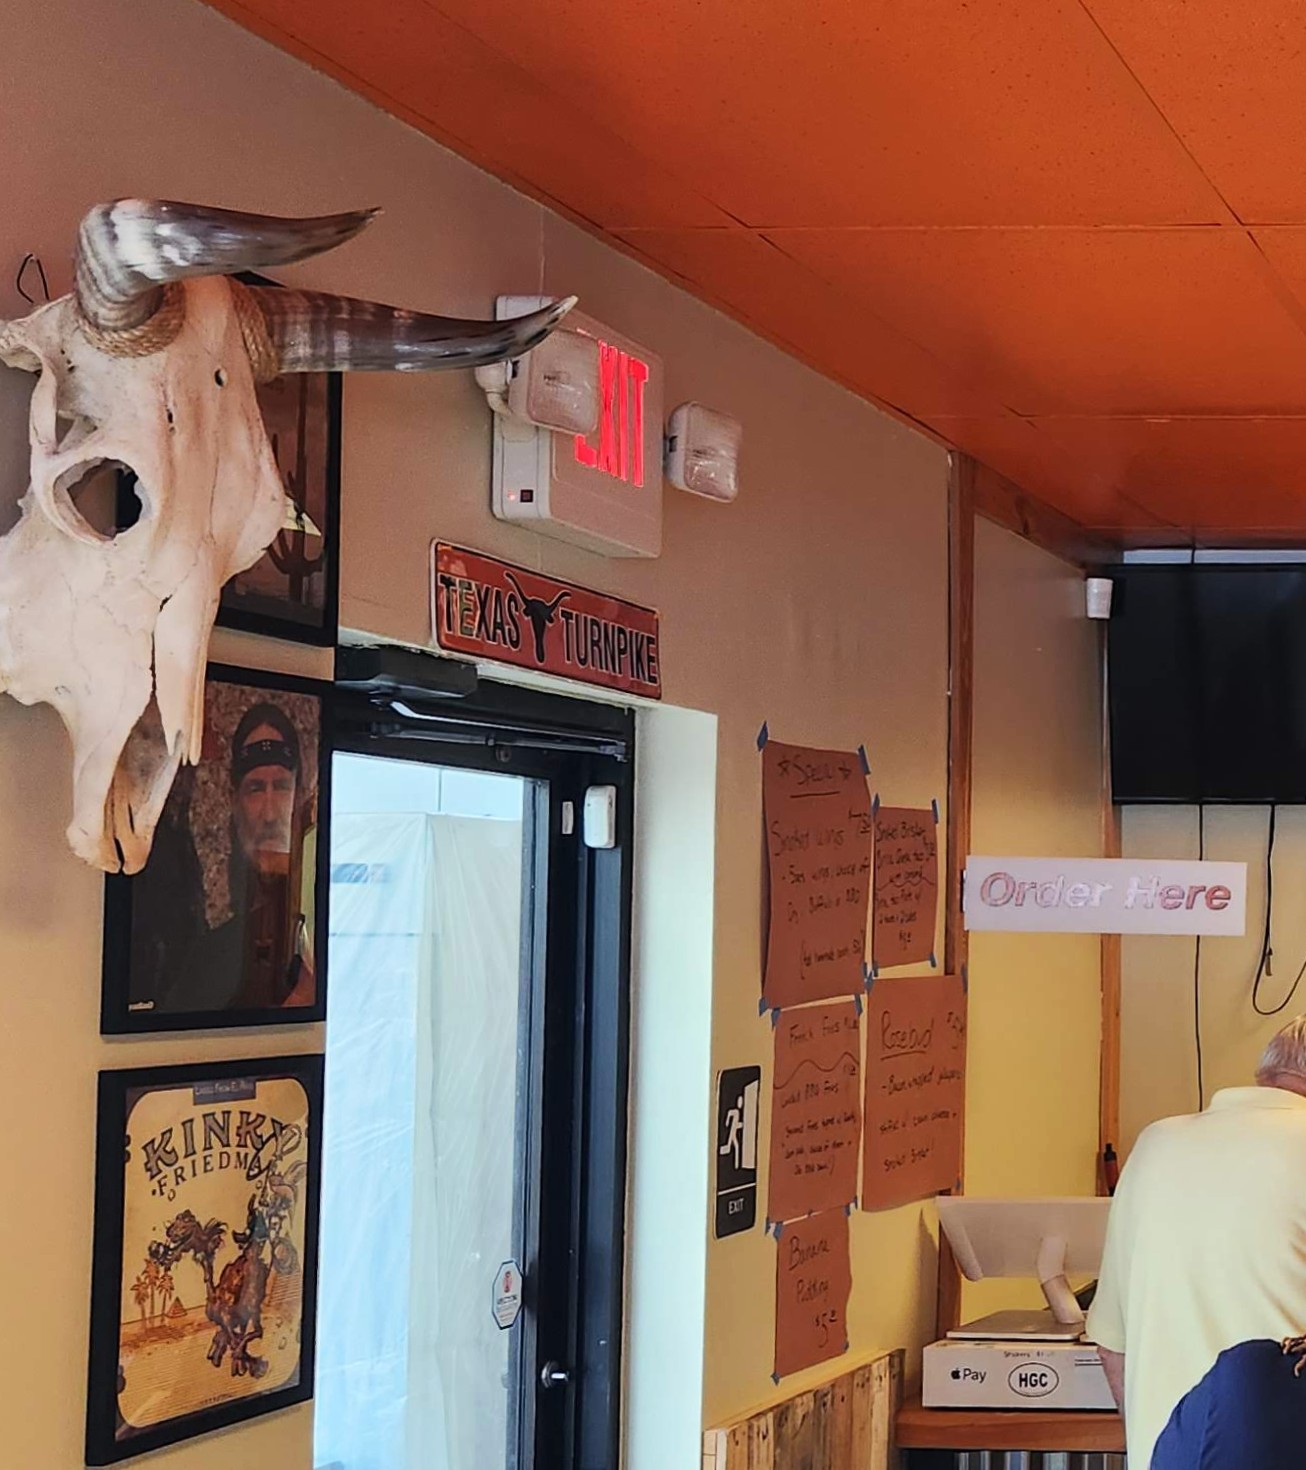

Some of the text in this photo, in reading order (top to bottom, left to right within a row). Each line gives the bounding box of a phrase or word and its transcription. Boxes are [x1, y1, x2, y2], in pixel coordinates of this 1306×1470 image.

[573, 339, 649, 488] XIT
[437, 572, 659, 686] TEXAS TURNPIKE
[980, 871, 1231, 911] Order Here
[141, 1110, 292, 1182] KINKY
[728, 1198, 744, 1215] EXIT
[963, 1368, 986, 1384] Pay
[1018, 1372, 1048, 1388] HGC
